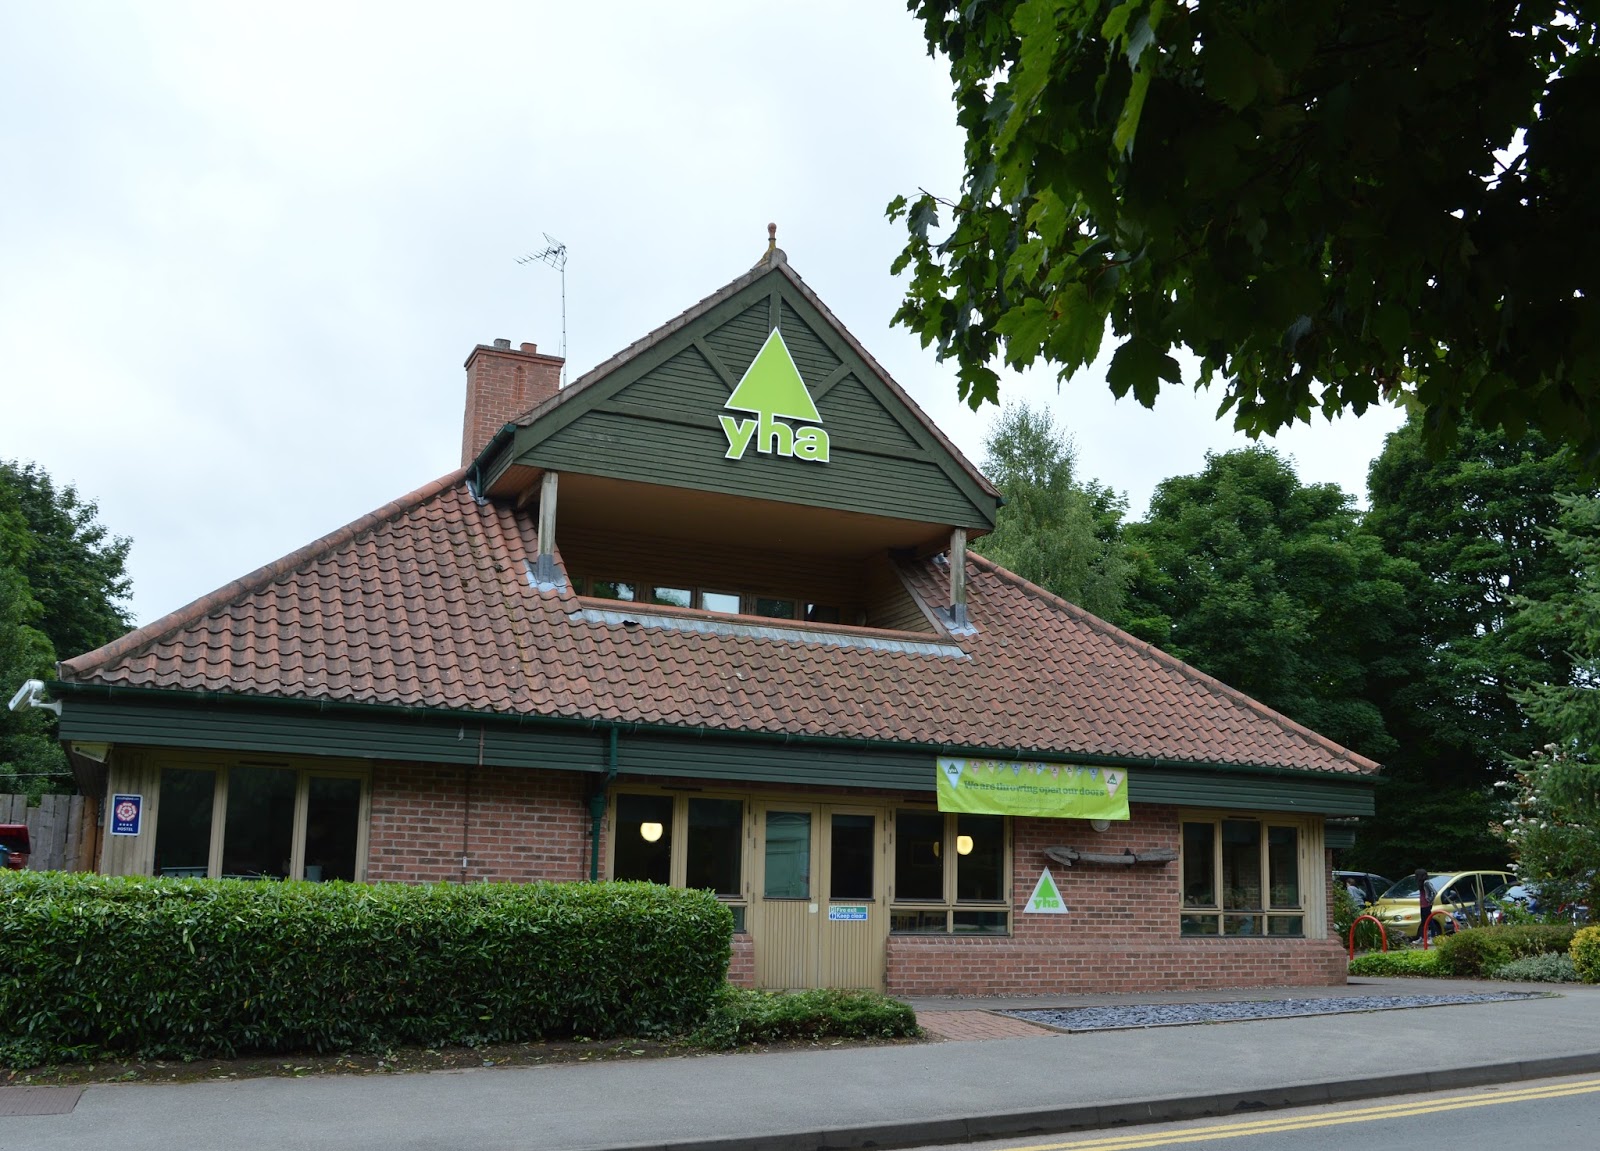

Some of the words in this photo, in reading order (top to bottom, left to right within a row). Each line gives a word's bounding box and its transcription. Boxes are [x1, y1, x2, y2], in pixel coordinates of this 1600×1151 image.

[718, 411, 830, 463] yha
[964, 781, 979, 789] We
[996, 782, 1038, 795] throwing
[1039, 786, 1061, 795] open
[1062, 787, 1078, 795] our
[1079, 786, 1105, 796] doors
[1033, 897, 1060, 910] yha
